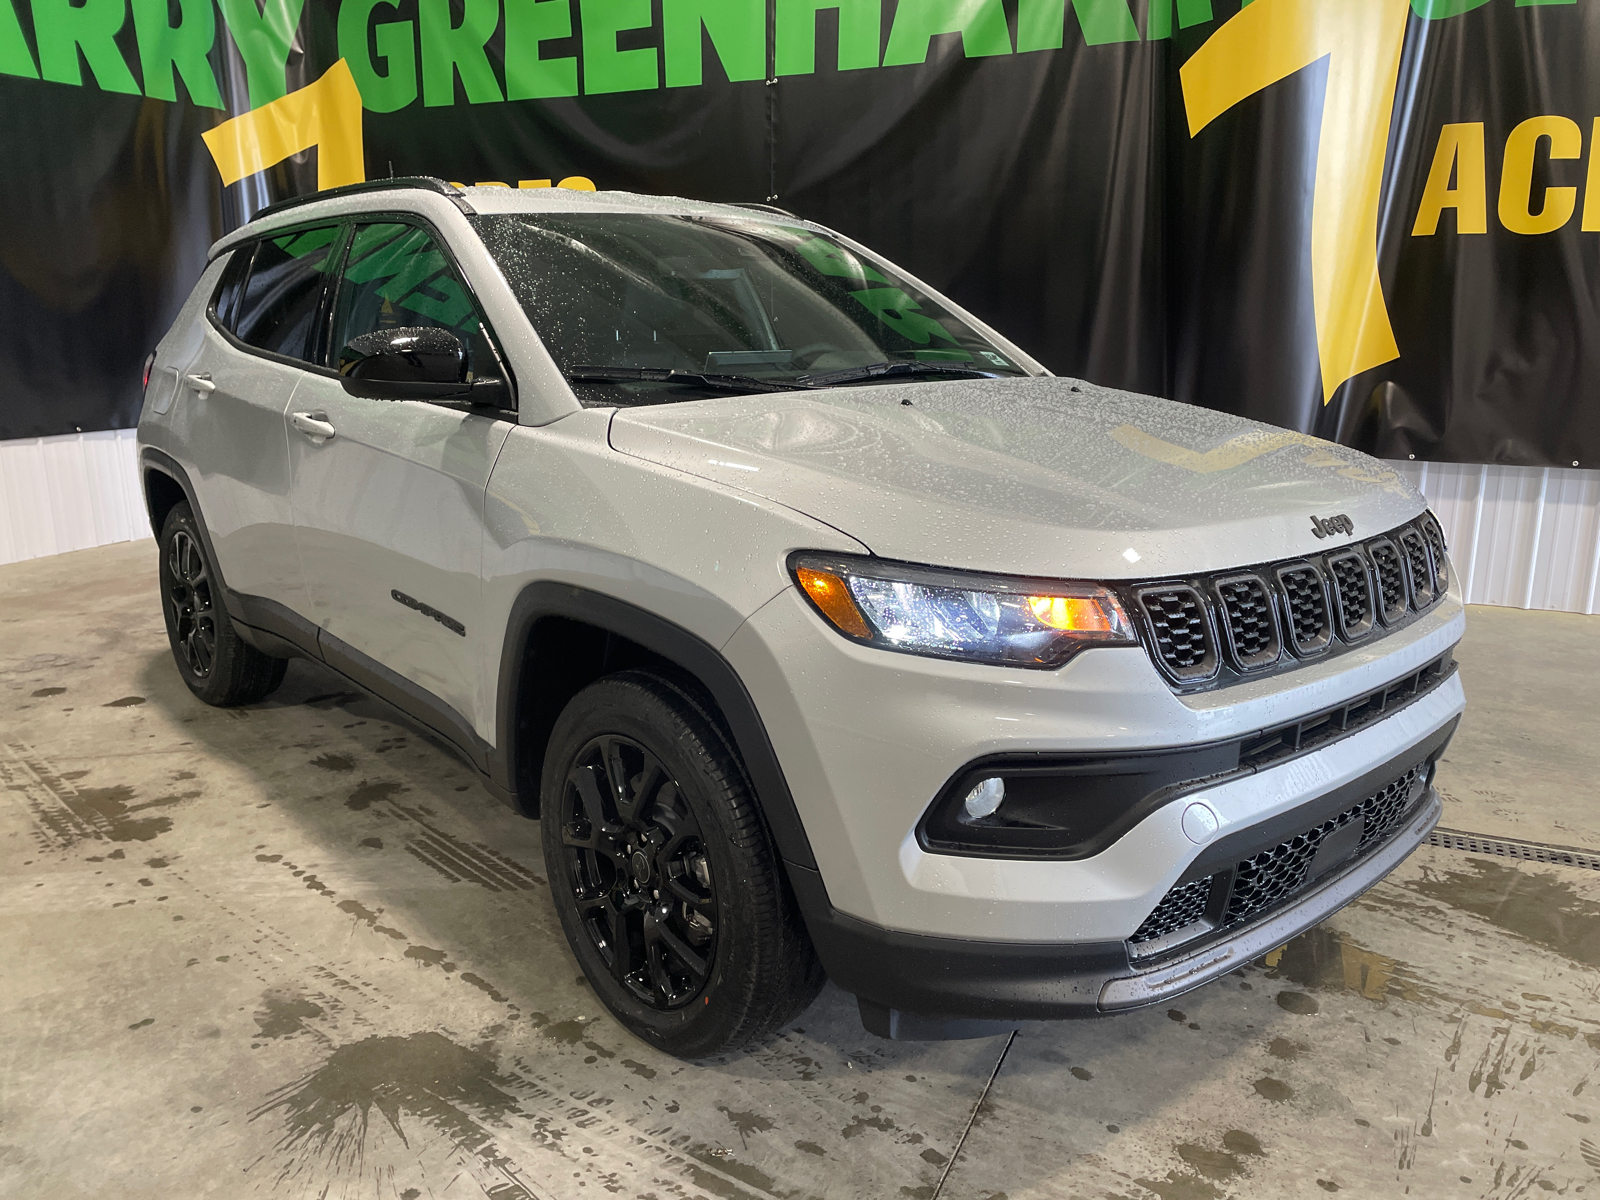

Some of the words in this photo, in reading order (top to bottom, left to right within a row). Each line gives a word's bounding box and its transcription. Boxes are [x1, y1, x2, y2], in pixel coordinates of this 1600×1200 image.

[0, 0, 304, 112] RRY
[1411, 115, 1600, 237] AC
[1309, 513, 1355, 540] Jeep
